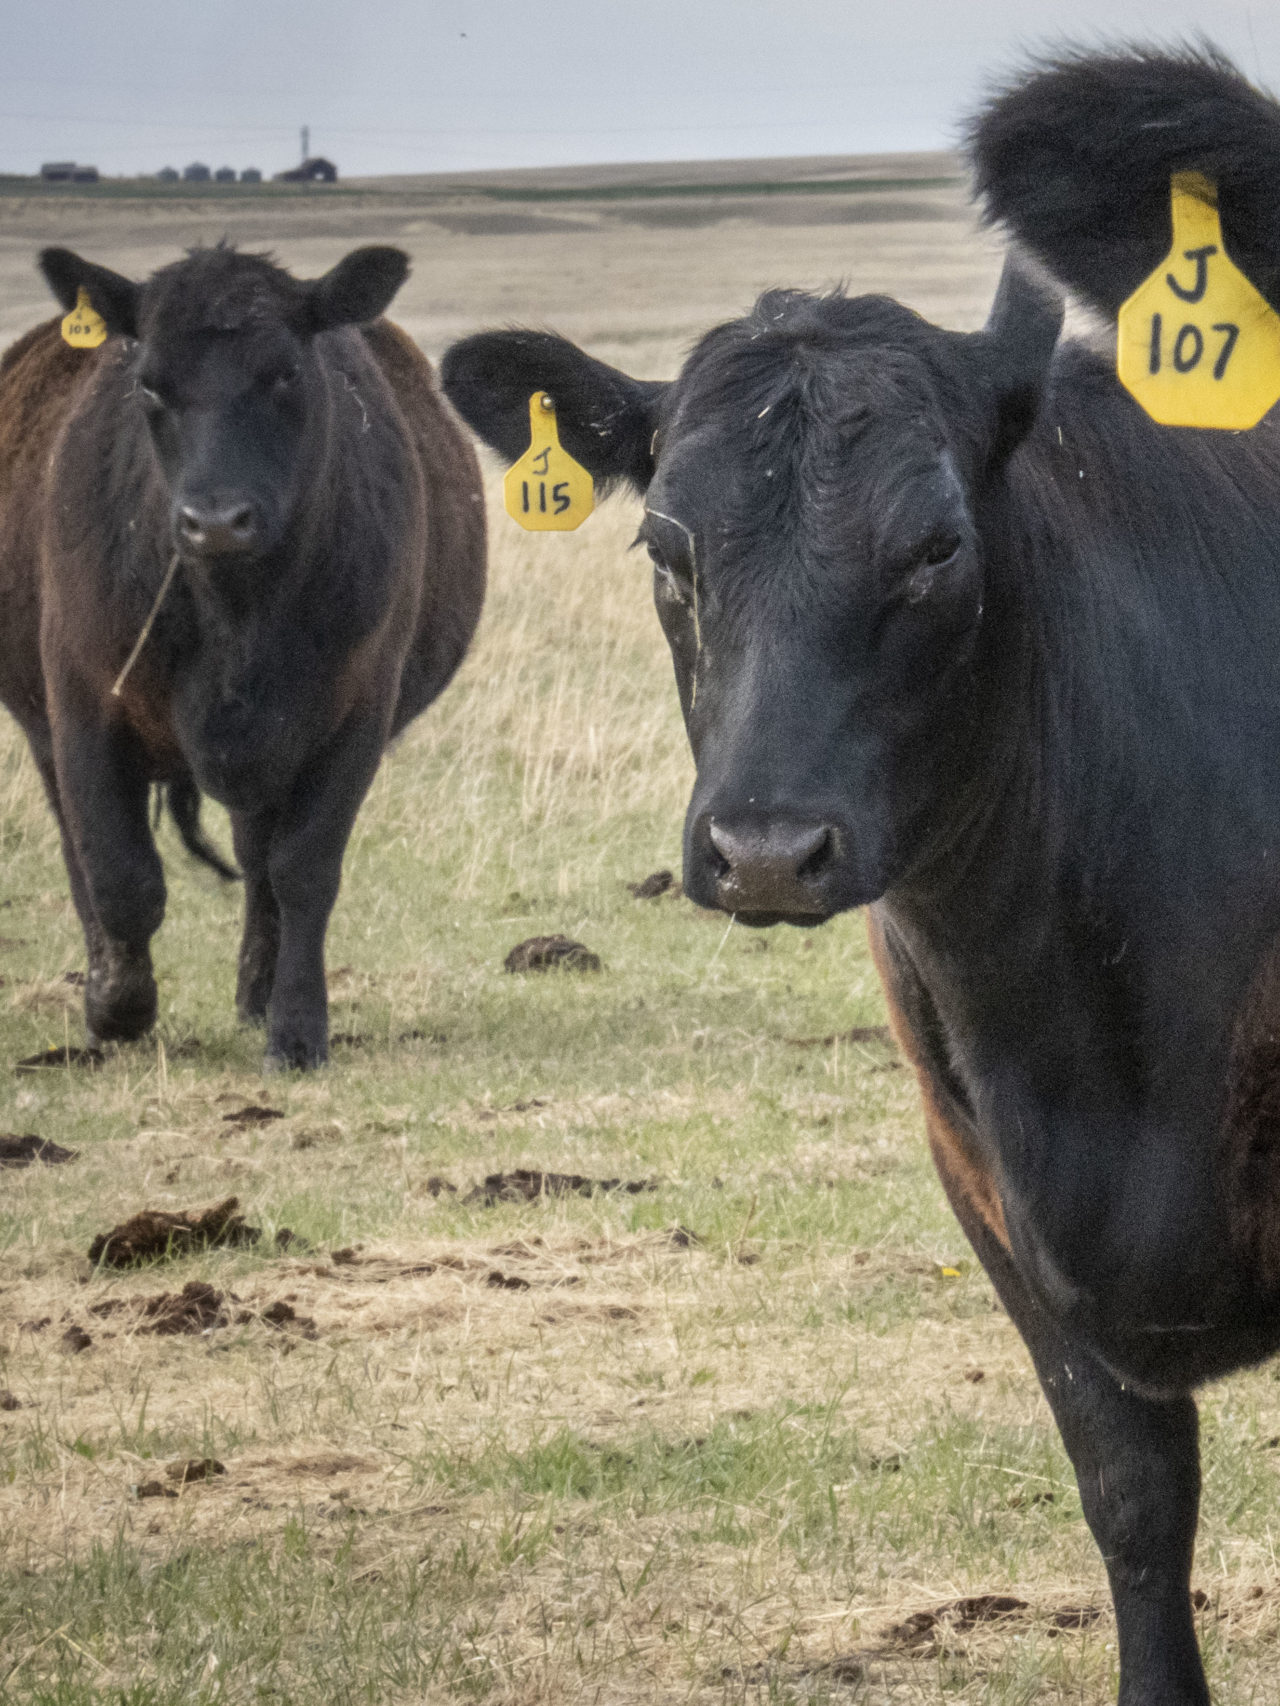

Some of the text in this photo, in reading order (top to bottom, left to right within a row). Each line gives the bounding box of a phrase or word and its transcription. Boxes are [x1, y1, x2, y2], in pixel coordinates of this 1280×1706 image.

[1166, 245, 1217, 304] J
[1149, 313, 1240, 381] 107
[532, 446, 552, 476] J
[522, 481, 571, 515] 115
